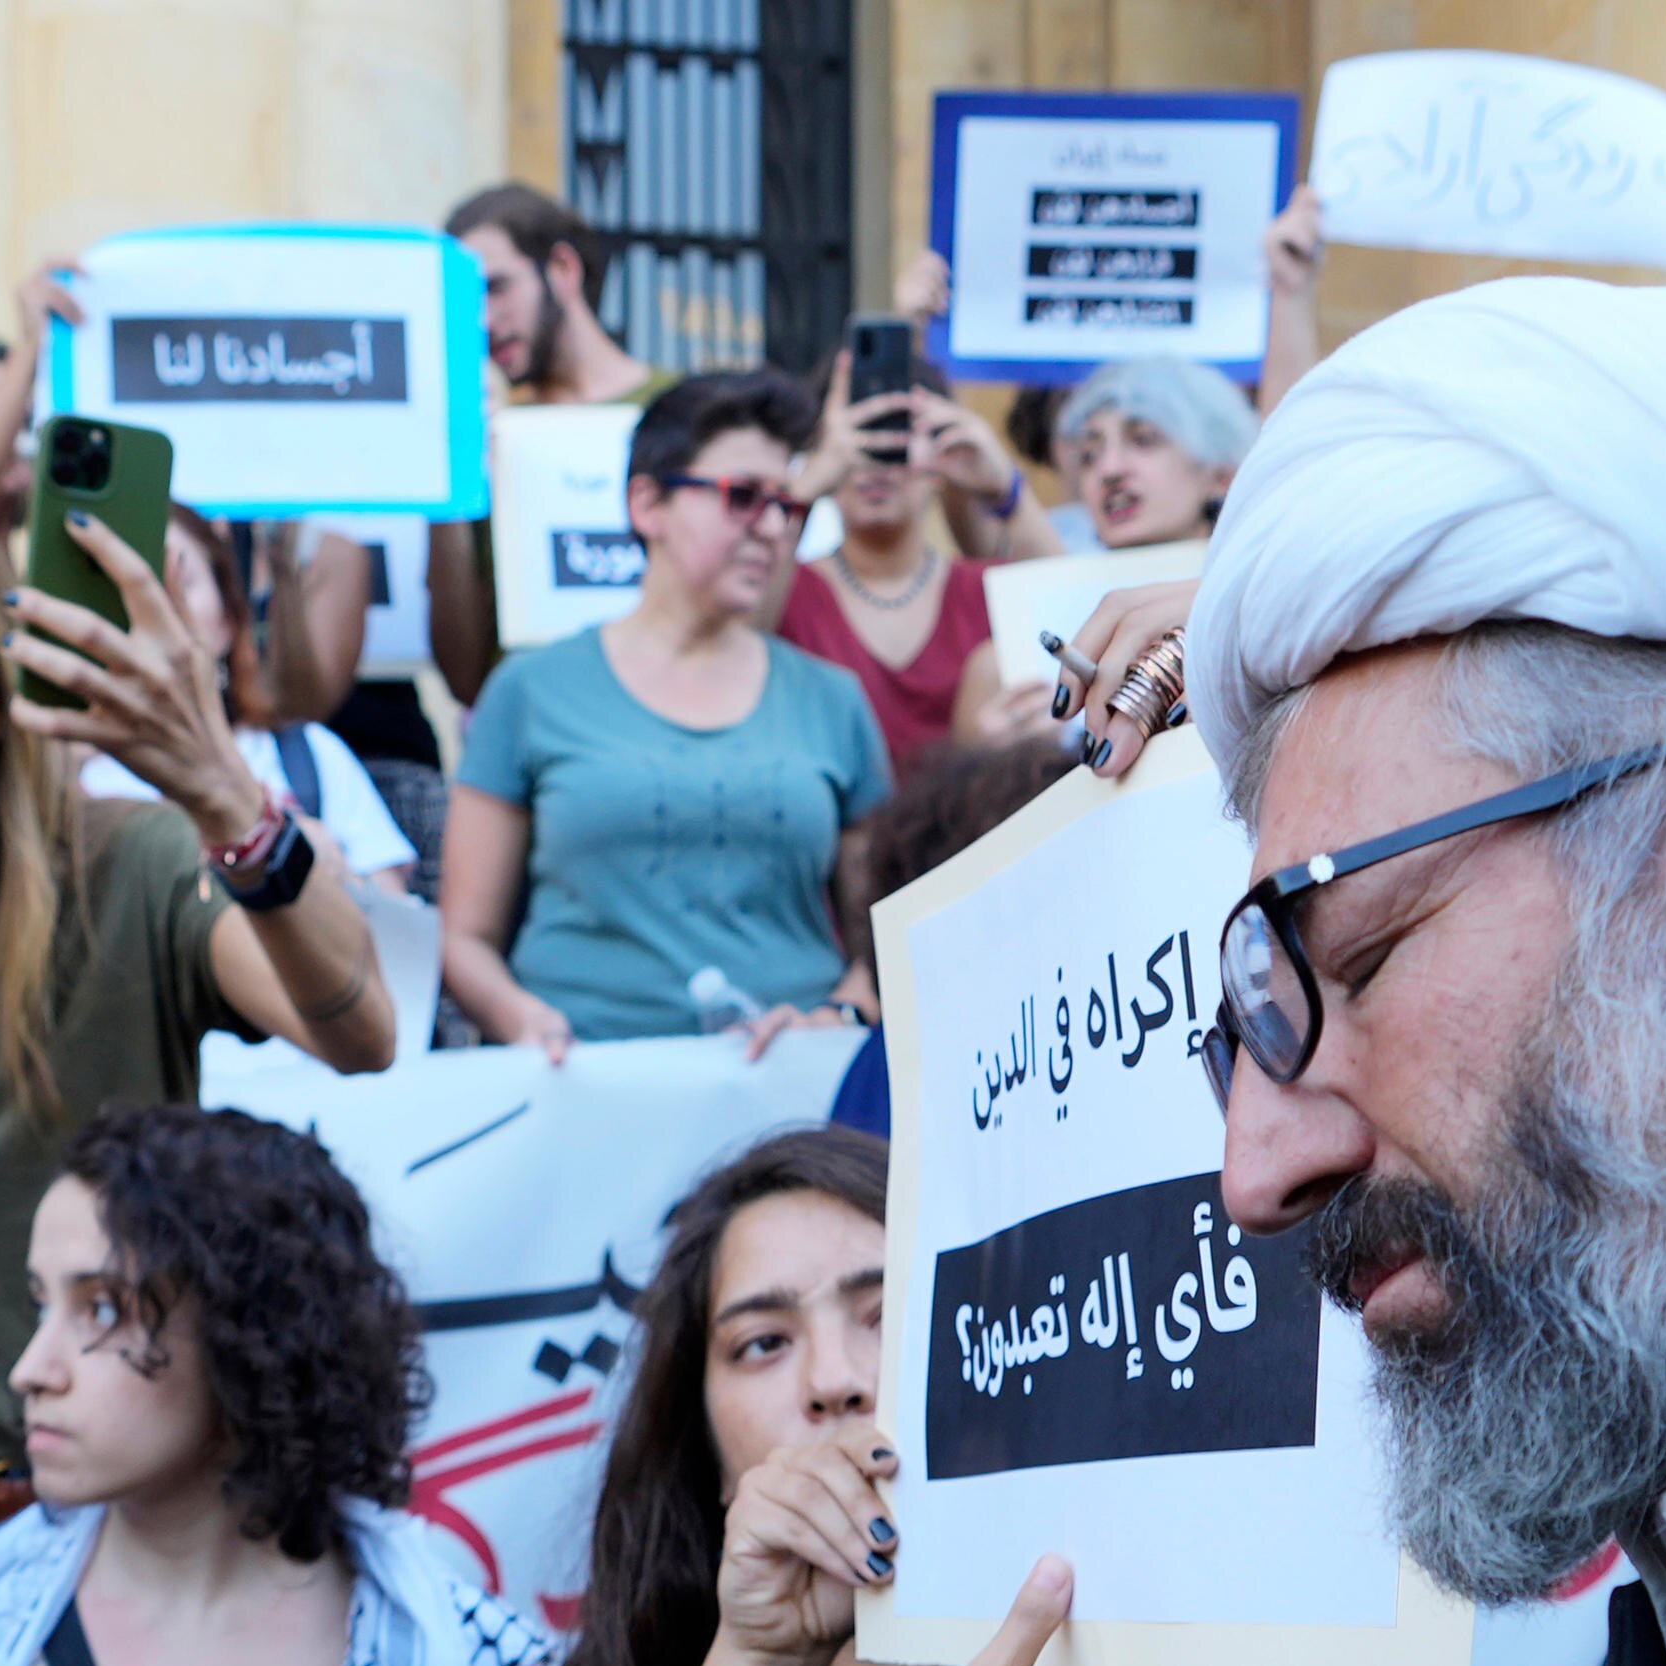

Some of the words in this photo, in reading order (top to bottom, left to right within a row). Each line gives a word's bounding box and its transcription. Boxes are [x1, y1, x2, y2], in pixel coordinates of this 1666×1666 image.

[153, 331, 206, 387] لنا
[214, 320, 374, 396] أجسادنا
[972, 994, 1036, 1132] الدين
[1048, 966, 1074, 1123] في
[1086, 930, 1203, 1069] إكراه
[954, 1273, 1071, 1398] تعبدون؟
[1080, 1251, 1144, 1381] إله
[1154, 1200, 1258, 1391] فأي
